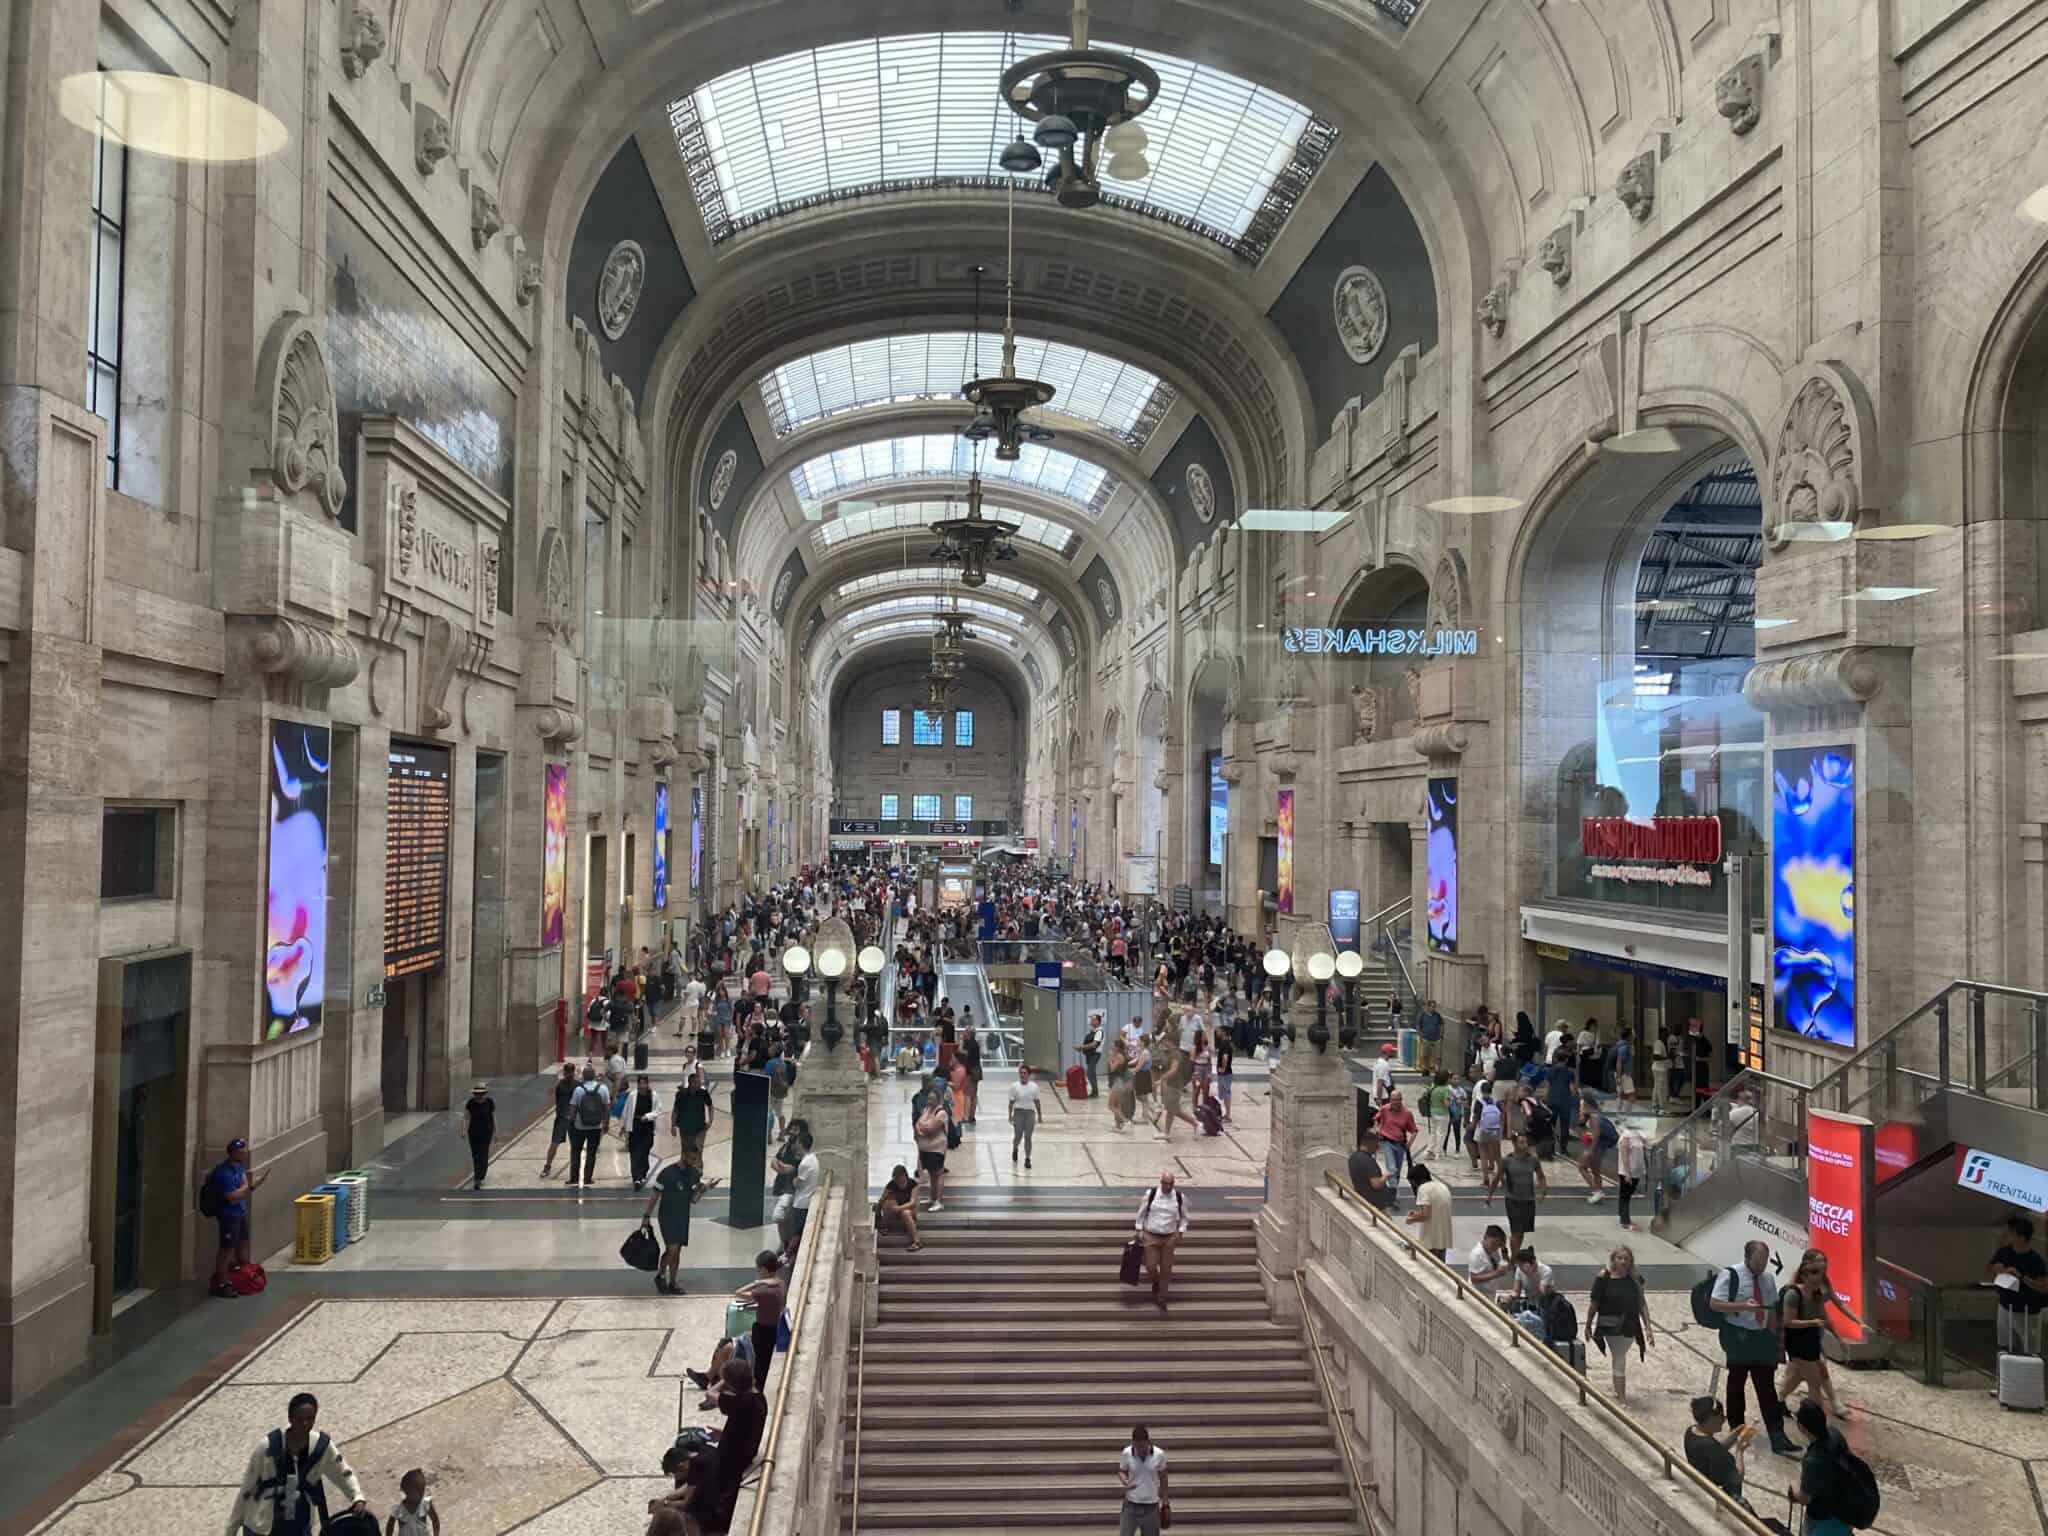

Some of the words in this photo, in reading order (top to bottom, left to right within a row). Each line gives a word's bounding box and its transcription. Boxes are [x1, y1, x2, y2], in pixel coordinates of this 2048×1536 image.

[1987, 1179, 2042, 1207] TRENITALIA
[1809, 1197, 1853, 1223] RECCIA
[1809, 1212, 1849, 1237] OUNGE
